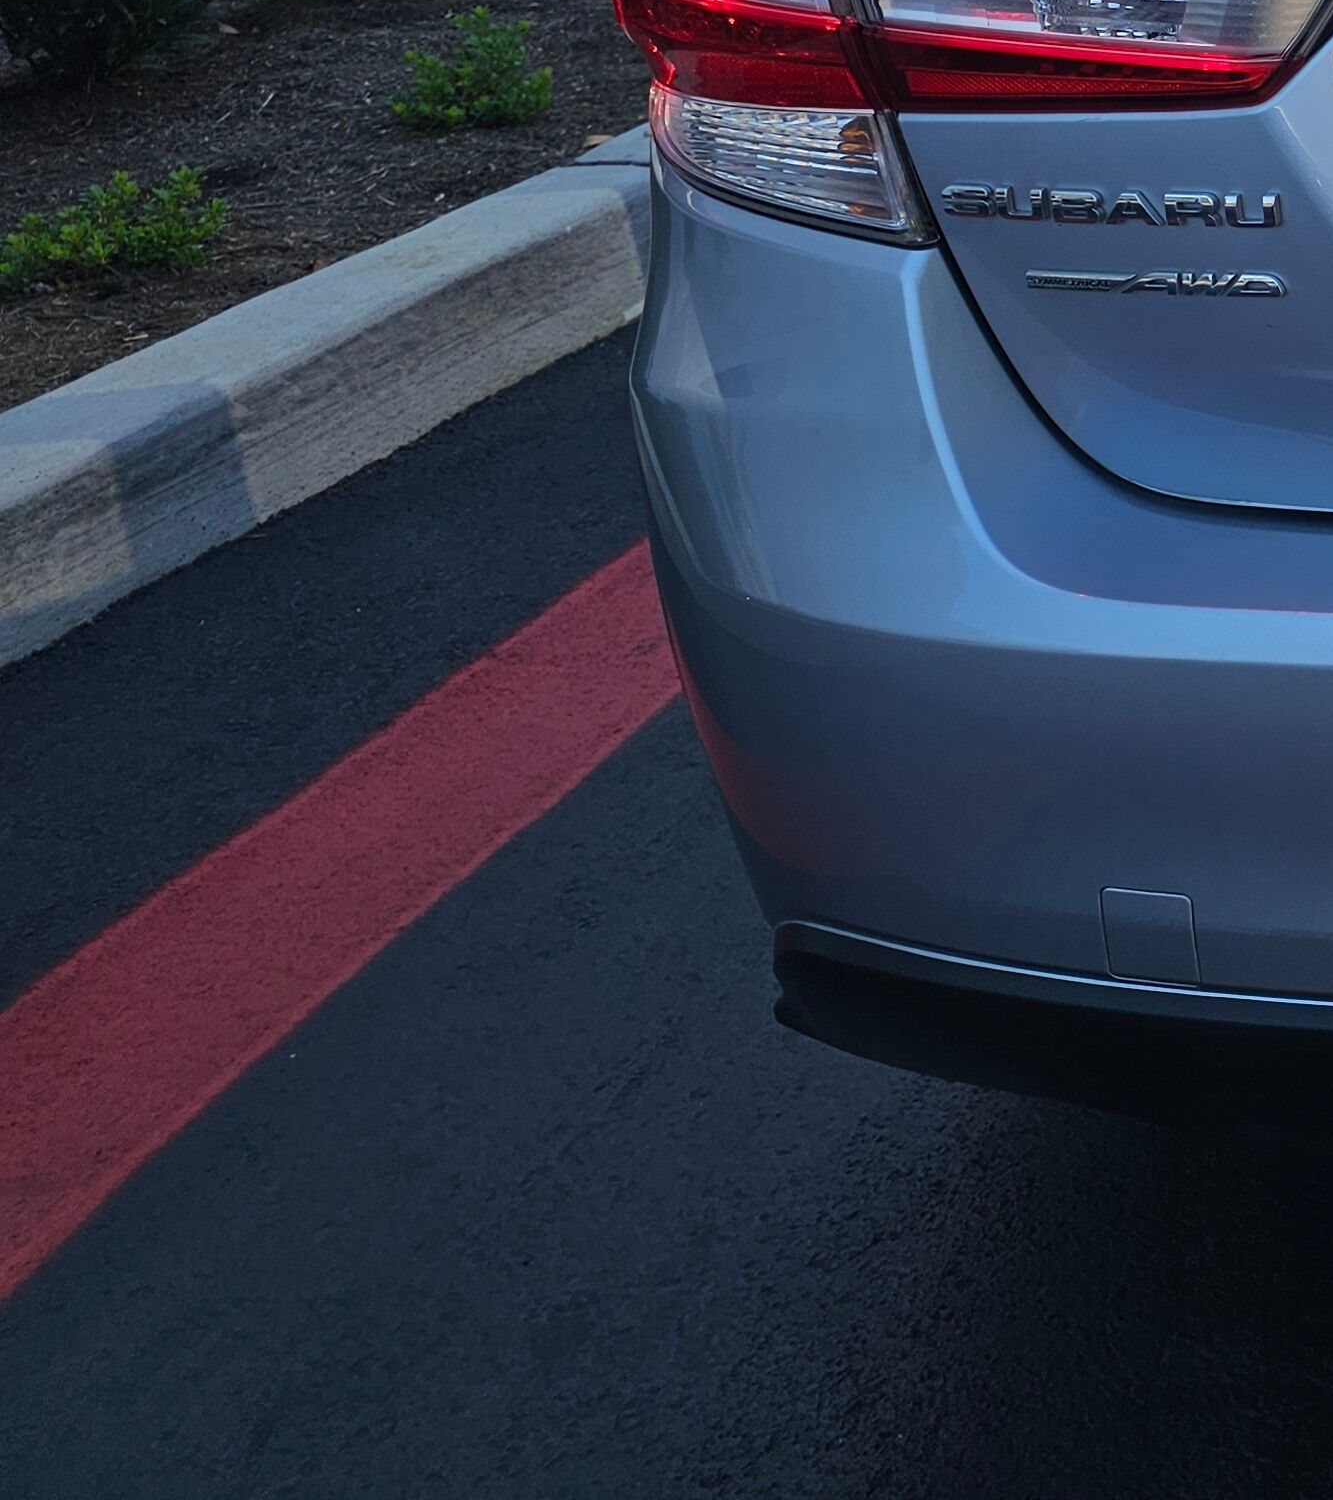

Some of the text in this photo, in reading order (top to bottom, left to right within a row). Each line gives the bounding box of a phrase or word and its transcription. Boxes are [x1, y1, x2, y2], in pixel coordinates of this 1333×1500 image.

[941, 183, 1284, 228] SUBARU
[1028, 269, 1288, 298] SYMMETRICAL AWD
